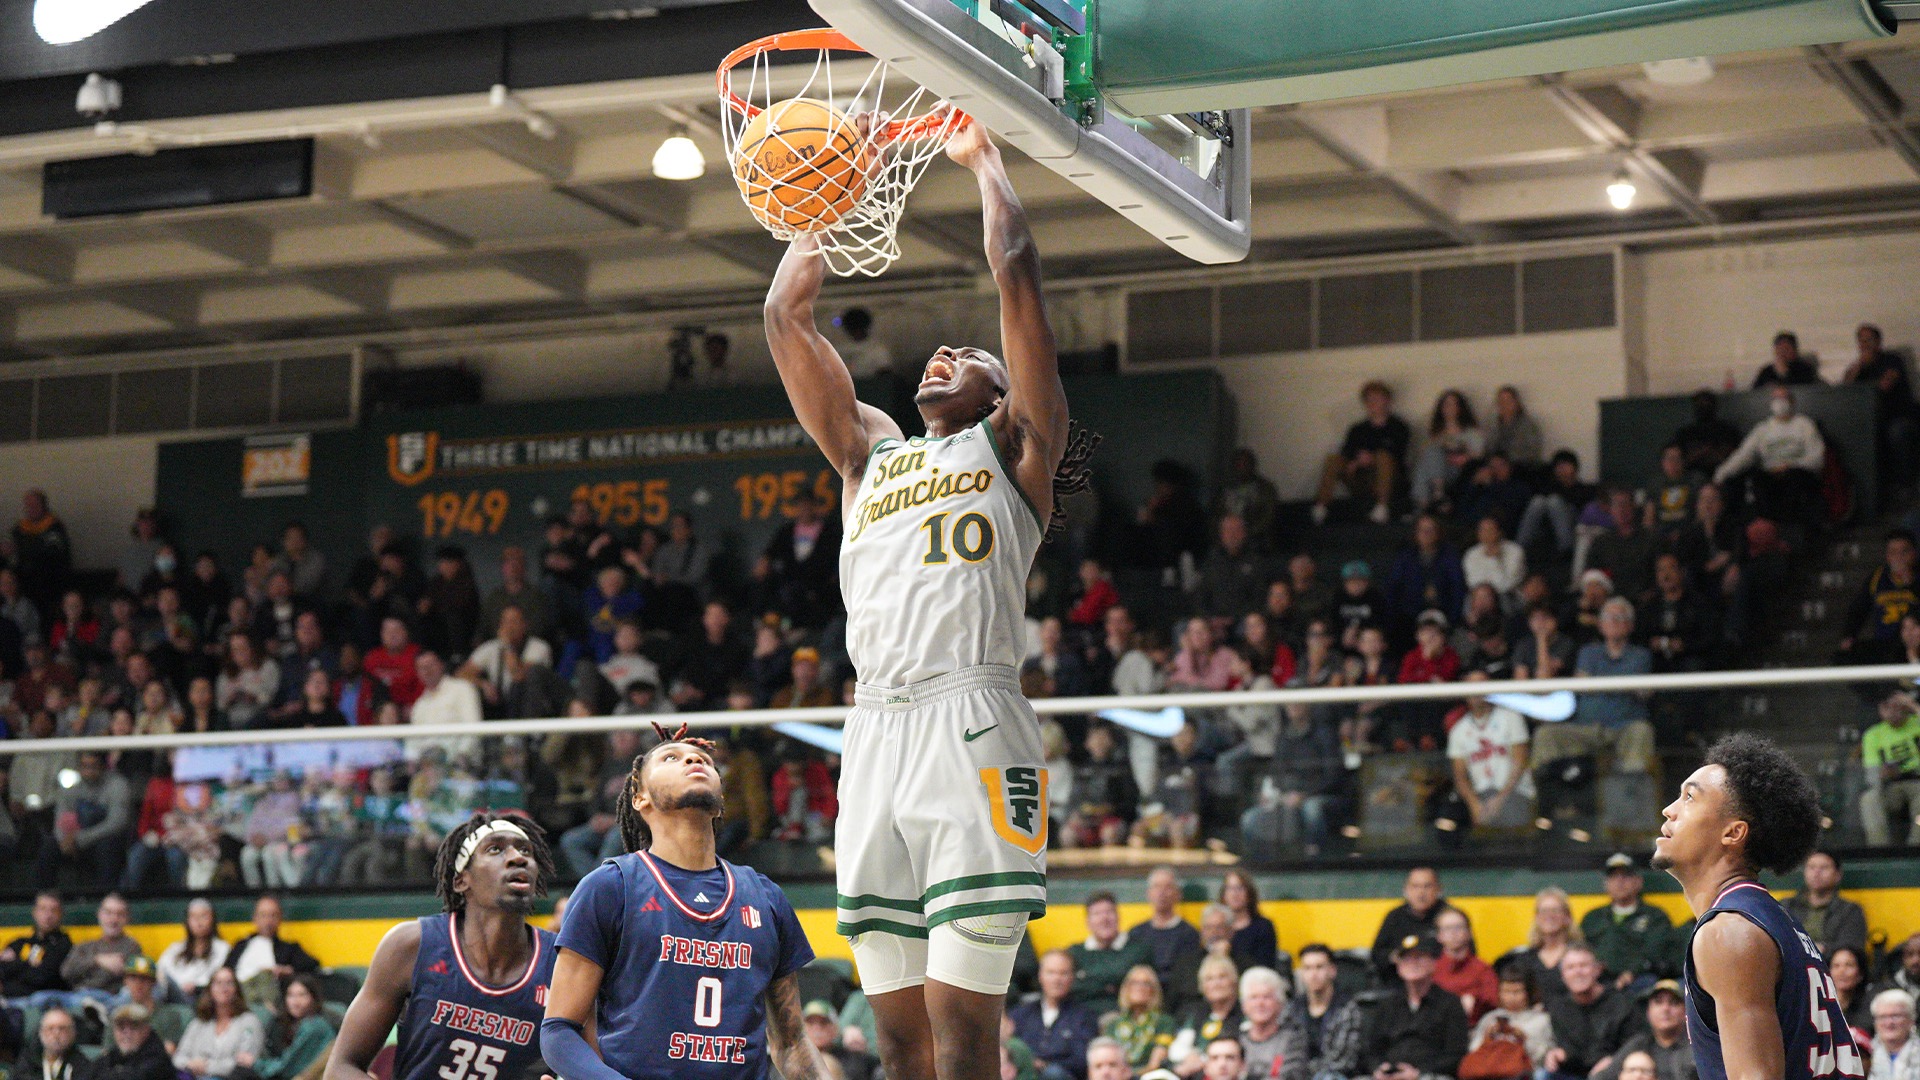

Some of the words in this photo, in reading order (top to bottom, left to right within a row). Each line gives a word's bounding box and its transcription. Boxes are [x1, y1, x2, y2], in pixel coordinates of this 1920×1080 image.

[442, 441, 518, 469] THREE
[524, 437, 582, 464] TIME
[587, 430, 710, 459] NATIONAL
[873, 449, 926, 489] San
[417, 489, 509, 538] 1949
[850, 468, 995, 542] Francisco
[920, 511, 995, 567] 10
[659, 934, 752, 970] FRESNO
[431, 999, 535, 1046] FRESNO
[693, 976, 723, 1028] 0
[438, 1037, 508, 1080] 35
[668, 1031, 746, 1066] STATE
